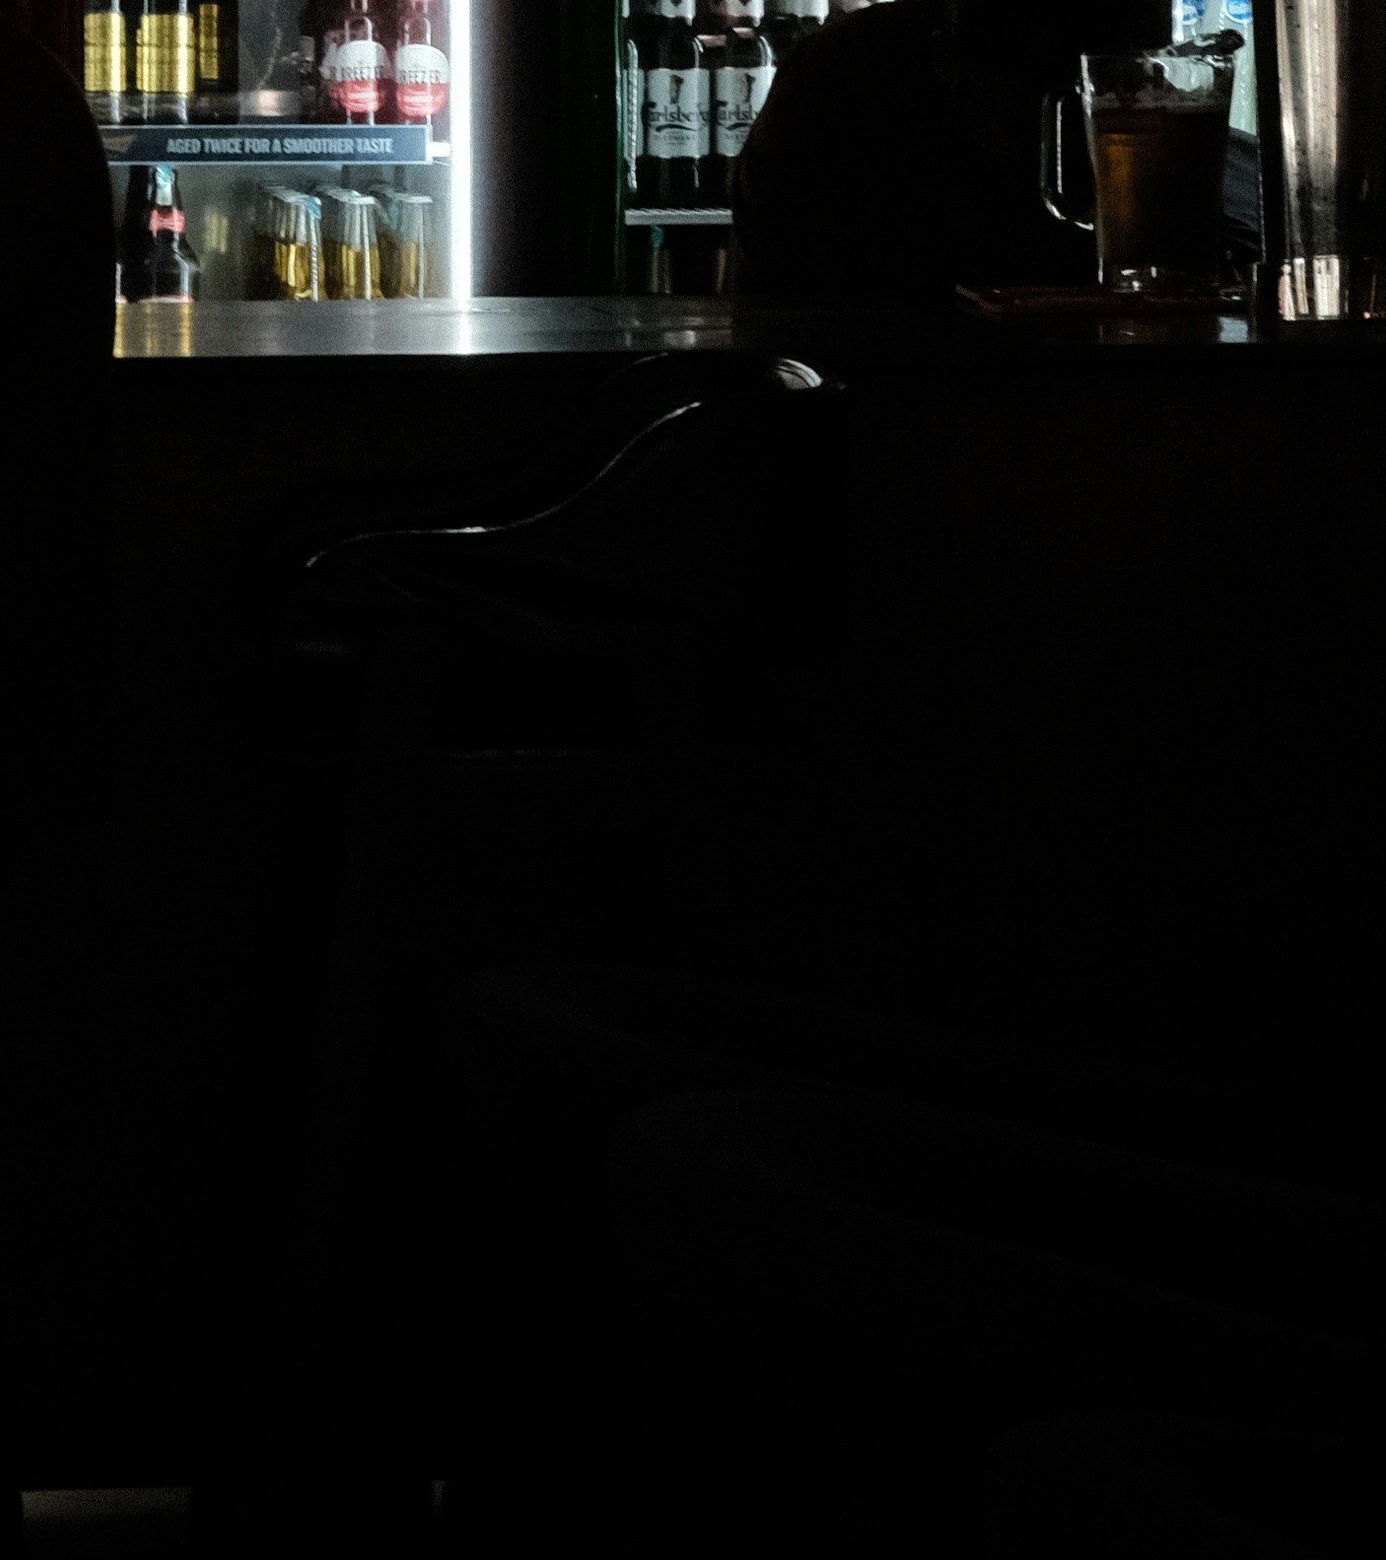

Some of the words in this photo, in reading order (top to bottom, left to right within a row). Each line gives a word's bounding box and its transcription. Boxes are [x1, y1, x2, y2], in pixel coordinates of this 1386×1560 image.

[166, 137, 201, 154] AGED
[202, 137, 243, 154] TWICE
[243, 137, 271, 154] FOR
[271, 138, 282, 154] A
[282, 137, 355, 154] SMOOTHER
[355, 137, 394, 154] TASTE
